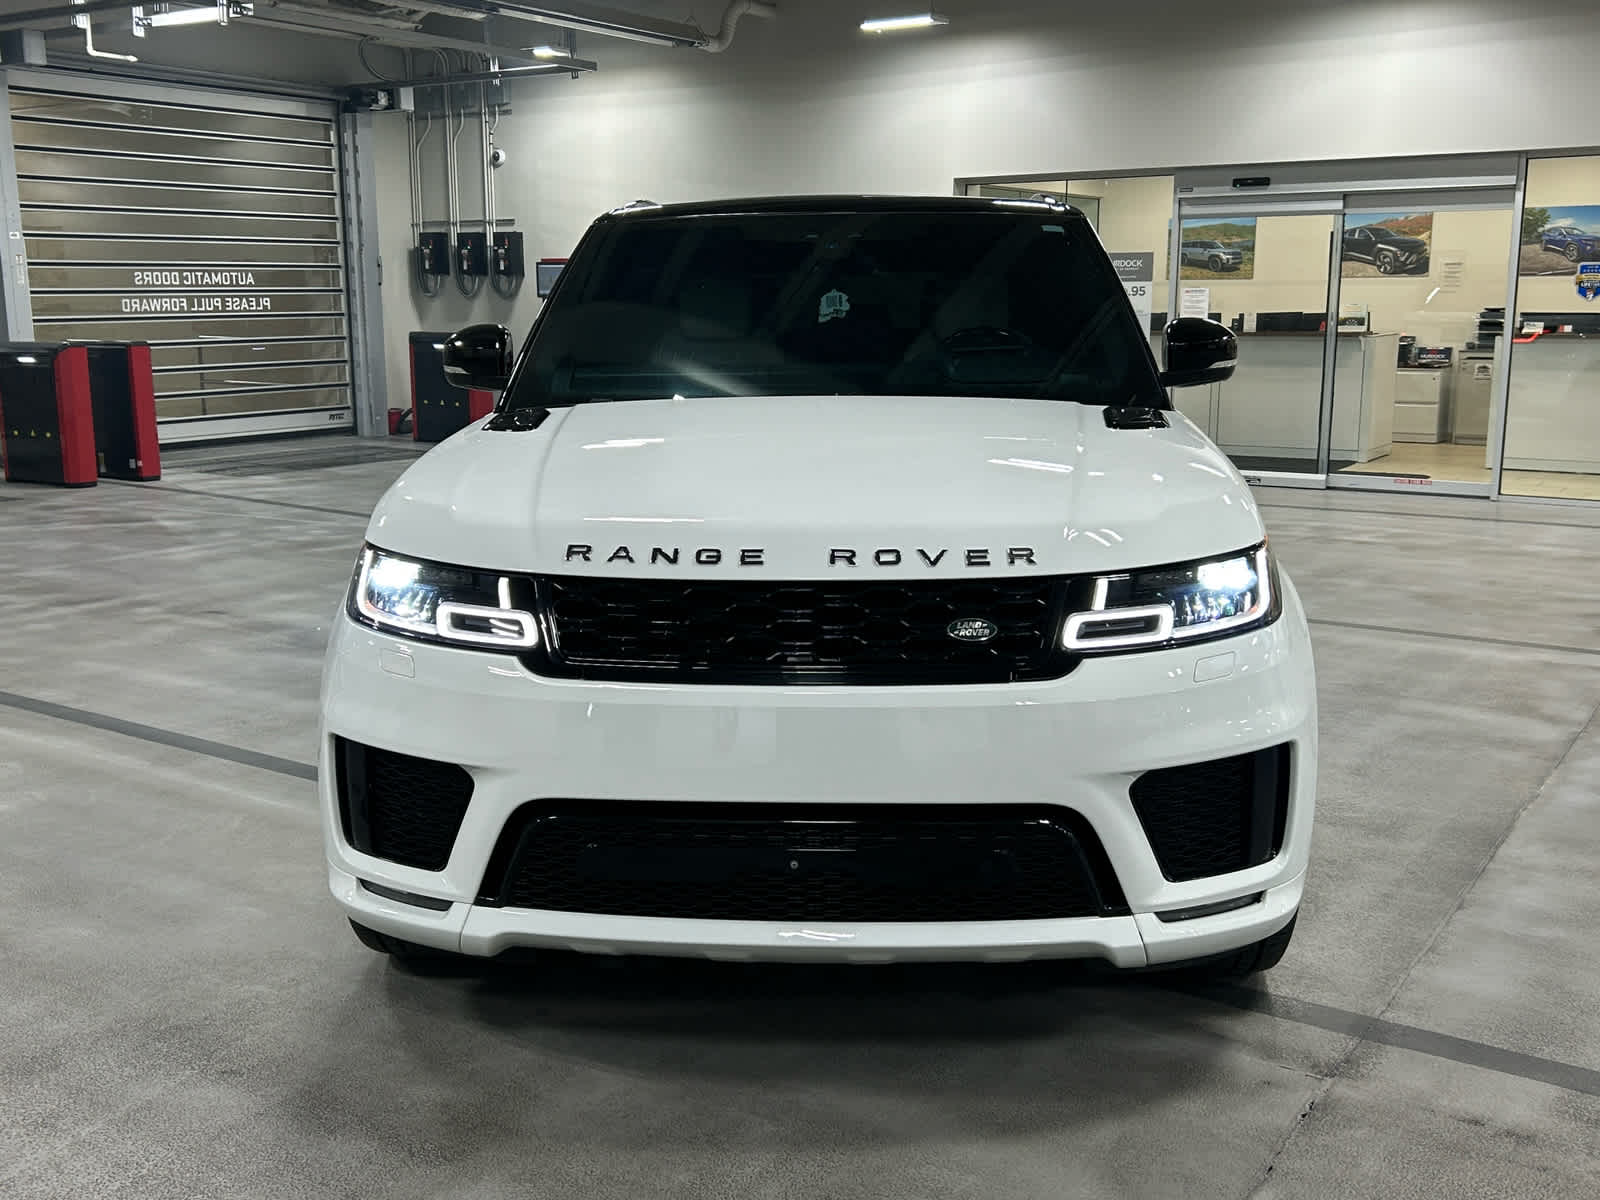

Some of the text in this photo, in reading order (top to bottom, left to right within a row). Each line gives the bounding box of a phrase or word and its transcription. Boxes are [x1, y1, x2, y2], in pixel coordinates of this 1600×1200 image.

[1126, 286, 1146, 296] .95
[565, 544, 1037, 567] RANGE ROVER
